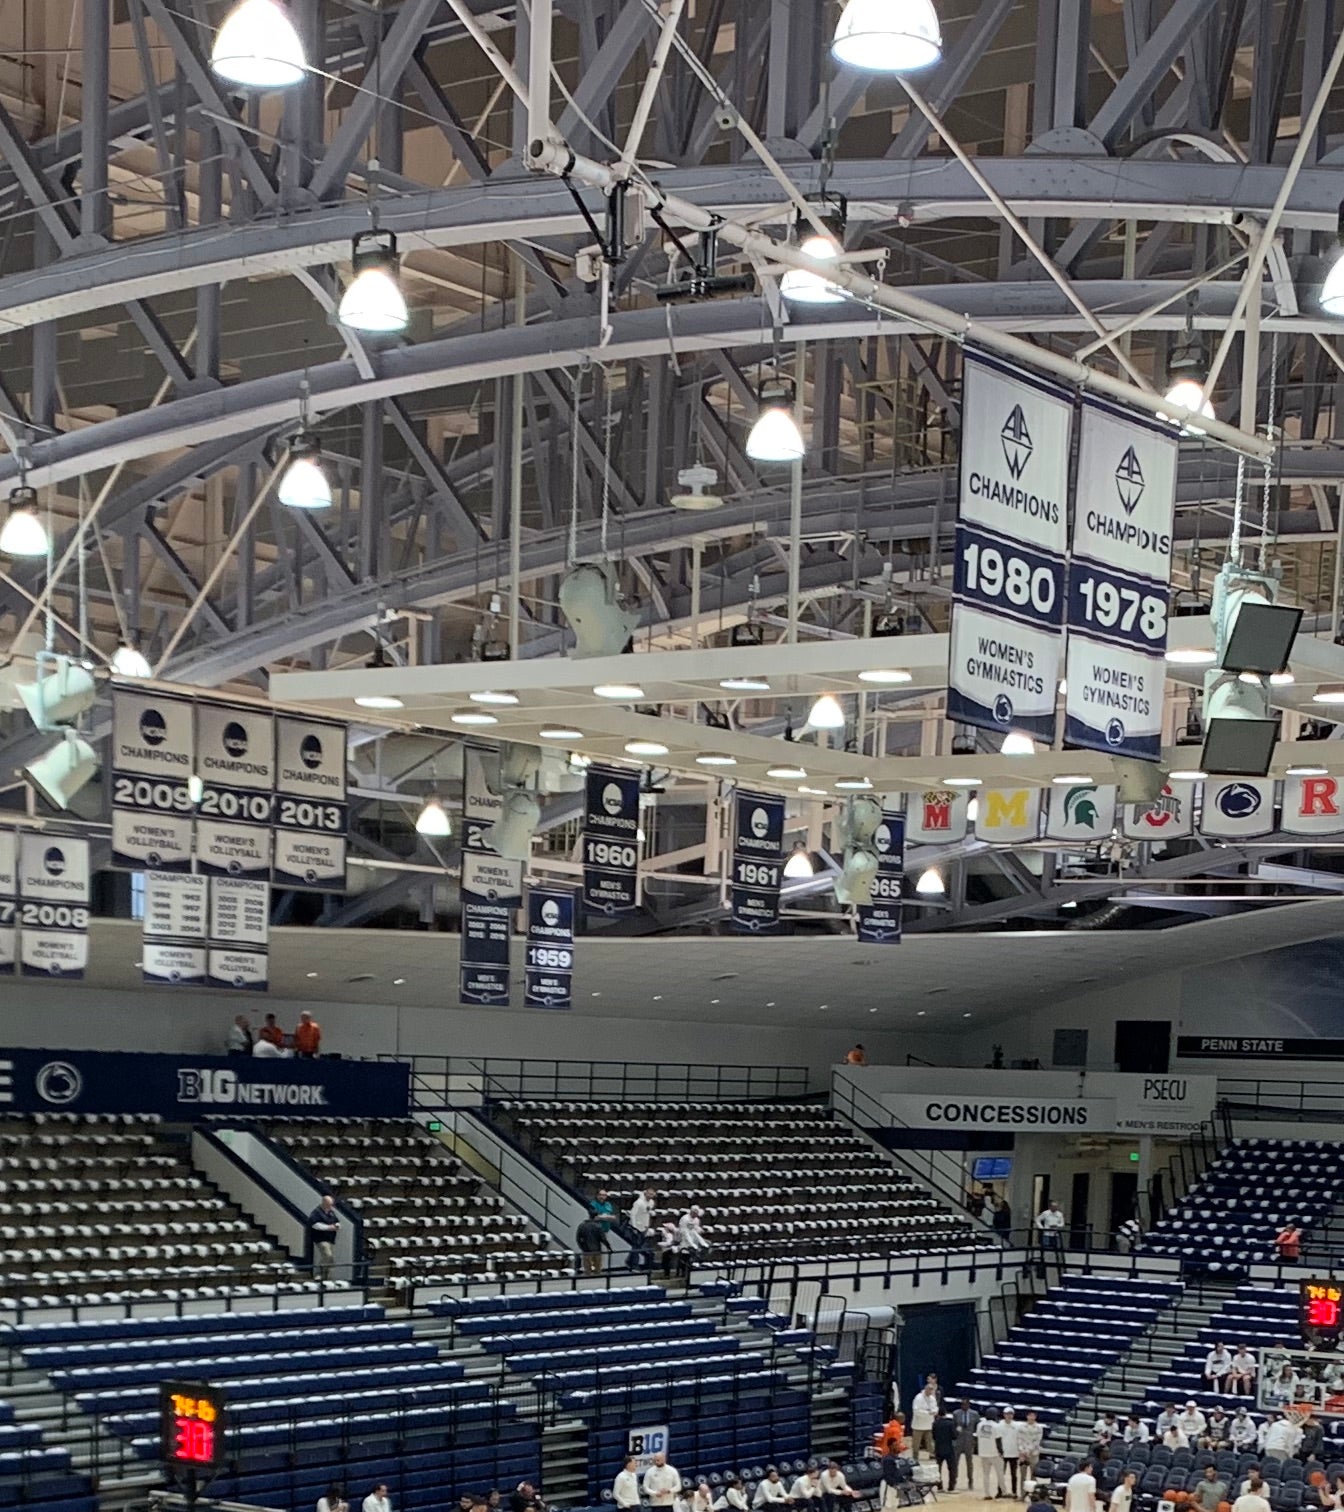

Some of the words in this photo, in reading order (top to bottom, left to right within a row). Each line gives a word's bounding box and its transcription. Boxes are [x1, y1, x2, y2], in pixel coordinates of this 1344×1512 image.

[970, 471, 1059, 524] CHAMPIONS
[964, 543, 1054, 613] 1980
[1080, 577, 1167, 639] 1978
[978, 636, 1033, 669] WOMEN'S
[967, 662, 1043, 694] GYMNASTICS
[1093, 665, 1144, 691] WOMEN'S
[1083, 687, 1150, 716] GYMNASTICS
[121, 745, 189, 765] CHAMPIONS
[204, 757, 268, 776] CHAMPIONS
[283, 769, 340, 786] CHAMPIONS
[115, 779, 194, 810] 2009
[201, 790, 270, 819] 2010
[1299, 777, 1339, 816] R
[280, 801, 340, 829] 2013
[922, 802, 951, 830] M
[985, 790, 1028, 827] M
[134, 825, 175, 837] WOMEN'S
[589, 814, 637, 830] CHAMPIONS
[127, 837, 181, 850] VOLLEYBALL
[210, 845, 262, 858] VOLLEYBALL
[214, 835, 255, 847] WOMEN'S
[293, 844, 330, 855] WOMEN'S
[285, 854, 335, 867] VOLLEYBALL
[588, 843, 635, 867] 1960
[27, 877, 85, 890] CHAMPIONS
[472, 875, 513, 888] VOLLEYBALL
[739, 863, 778, 885] 1961
[23, 904, 89, 928] 2008
[531, 925, 570, 937] CHAMPIONS
[530, 949, 571, 967] 1959
[1201, 1039, 1237, 1050] PENN
[1242, 1040, 1283, 1051] STATE
[238, 1084, 326, 1104] NETWORK
[1144, 1079, 1186, 1100] PSECU
[926, 1103, 1087, 1124] CONCESSIONS
[1126, 1121, 1154, 1129] MEN'S
[1309, 1301, 1337, 1325] 30
[176, 1420, 213, 1460] 30
